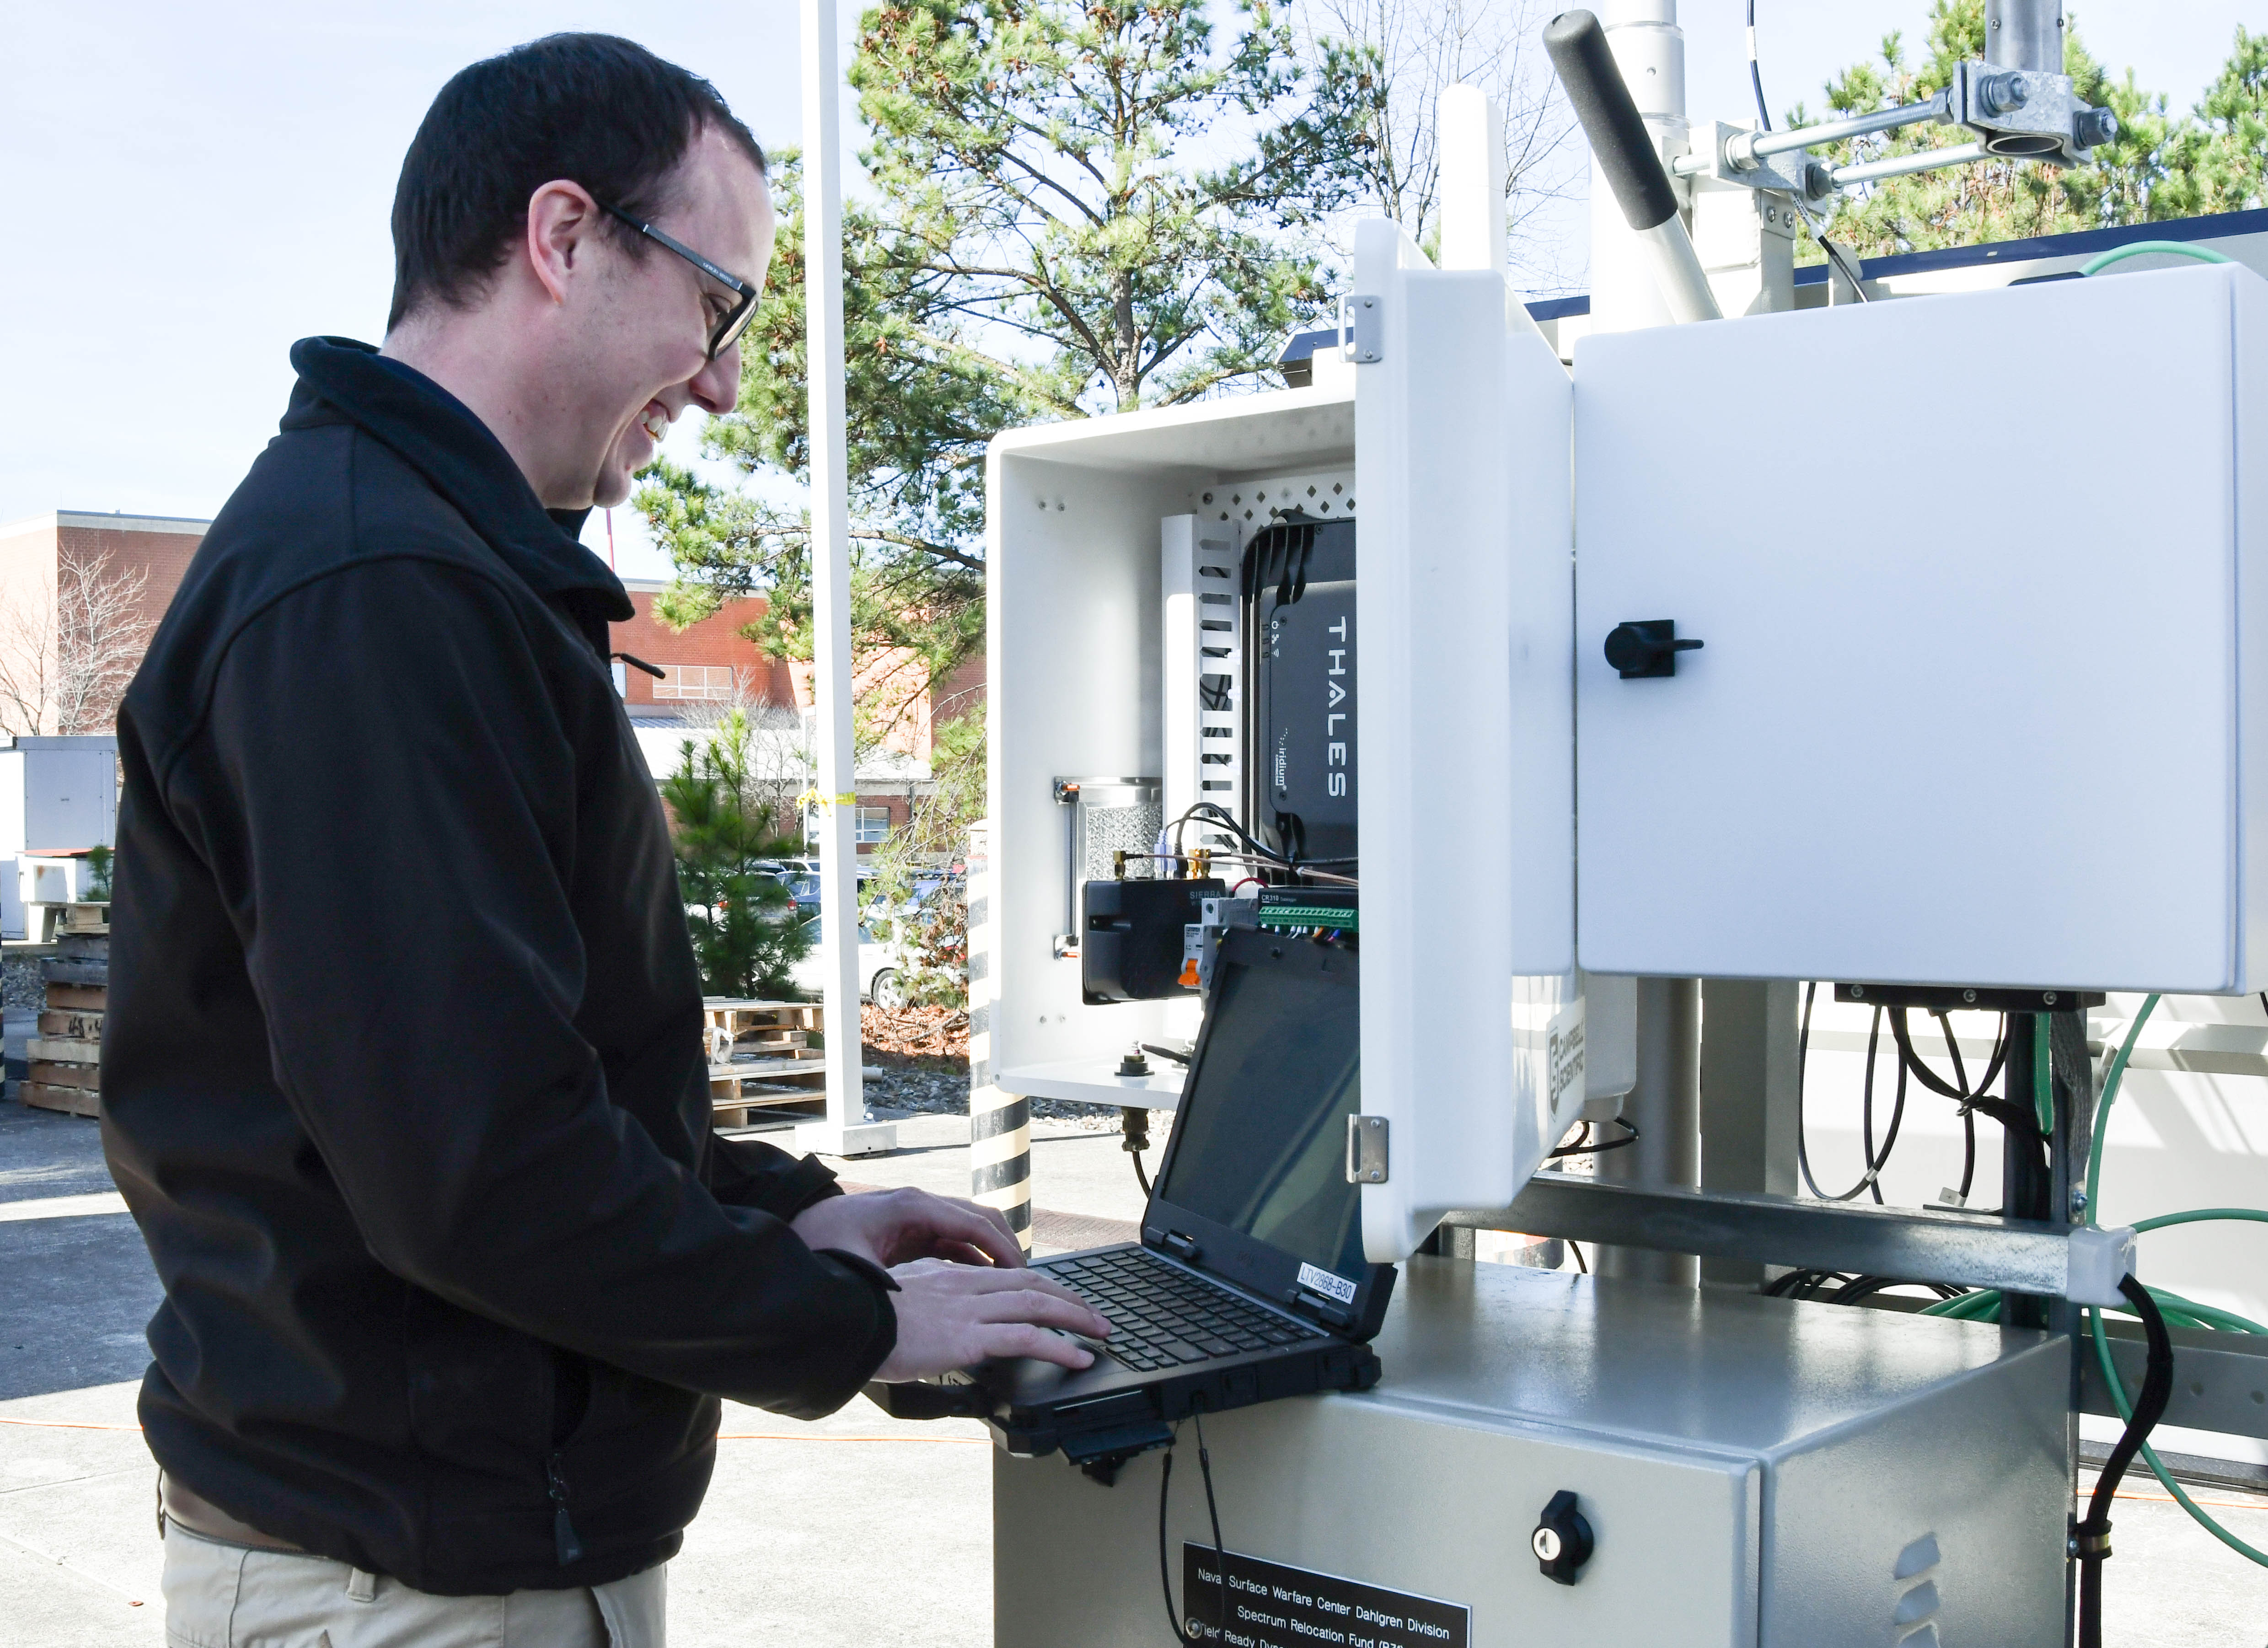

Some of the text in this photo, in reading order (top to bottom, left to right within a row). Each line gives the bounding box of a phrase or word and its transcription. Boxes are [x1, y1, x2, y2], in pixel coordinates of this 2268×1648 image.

[1327, 616, 1346, 797] THALES
[1190, 891, 1220, 899] SIERRA
[1198, 1567, 1450, 1639] Nava Surface Warfare Center Dahlgren Division
[1225, 1630, 1255, 1648] Ready
[1238, 1605, 1374, 1648] Spectrum Relocation Fund
